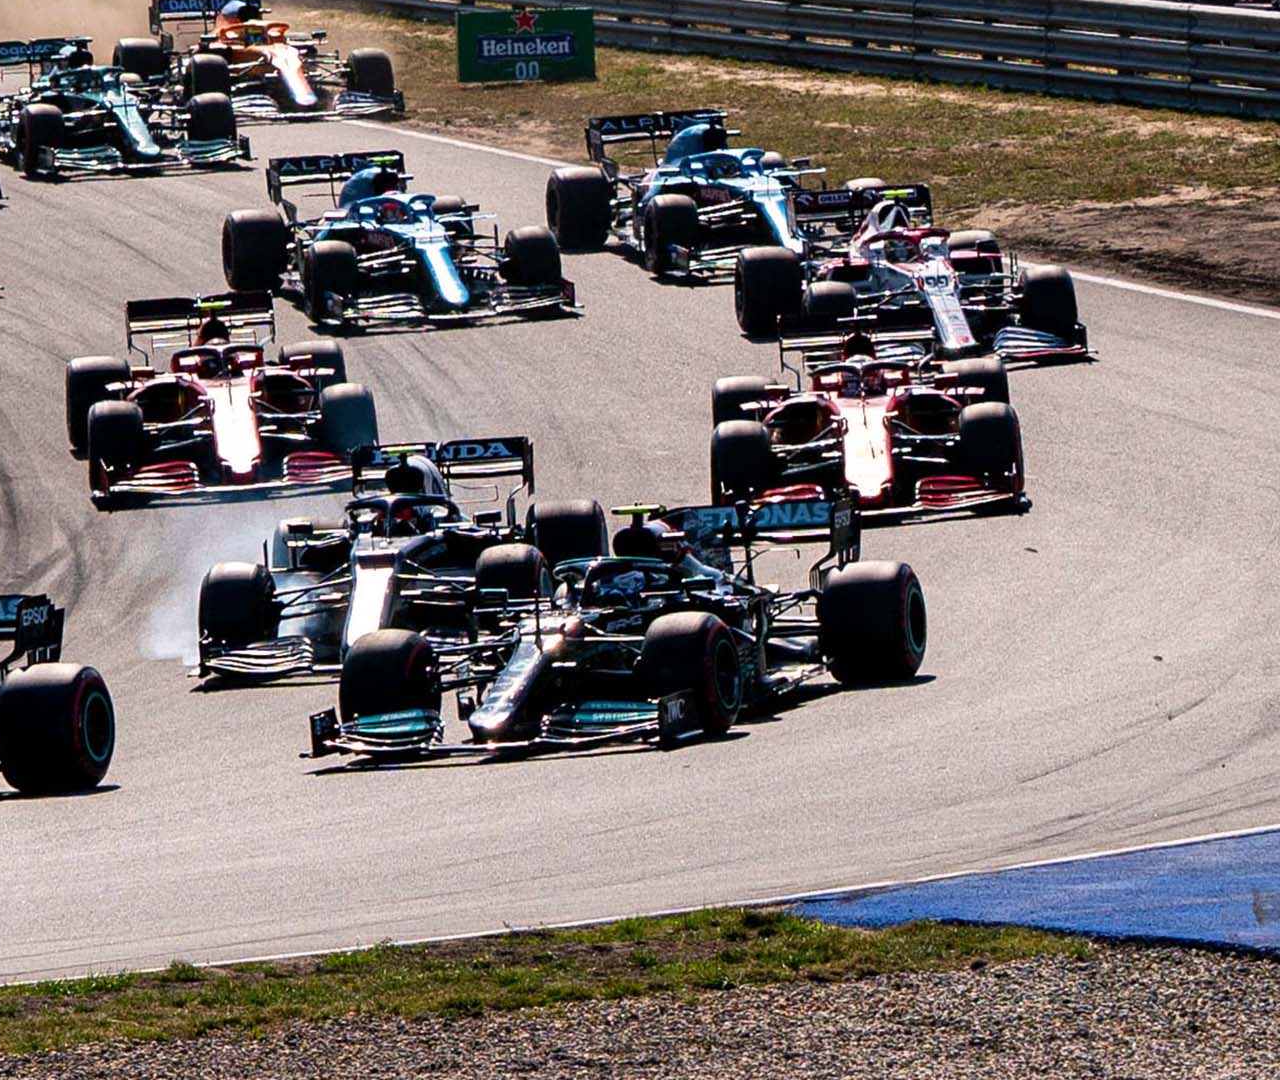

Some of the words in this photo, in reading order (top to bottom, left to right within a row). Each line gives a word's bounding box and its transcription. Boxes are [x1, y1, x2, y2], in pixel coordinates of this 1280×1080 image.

[482, 38, 570, 58] Heineken
[601, 115, 696, 131] ALPIN
[281, 157, 370, 171] ALPIN
[371, 441, 513, 465] HNDA
[683, 502, 831, 529] ETONAS
